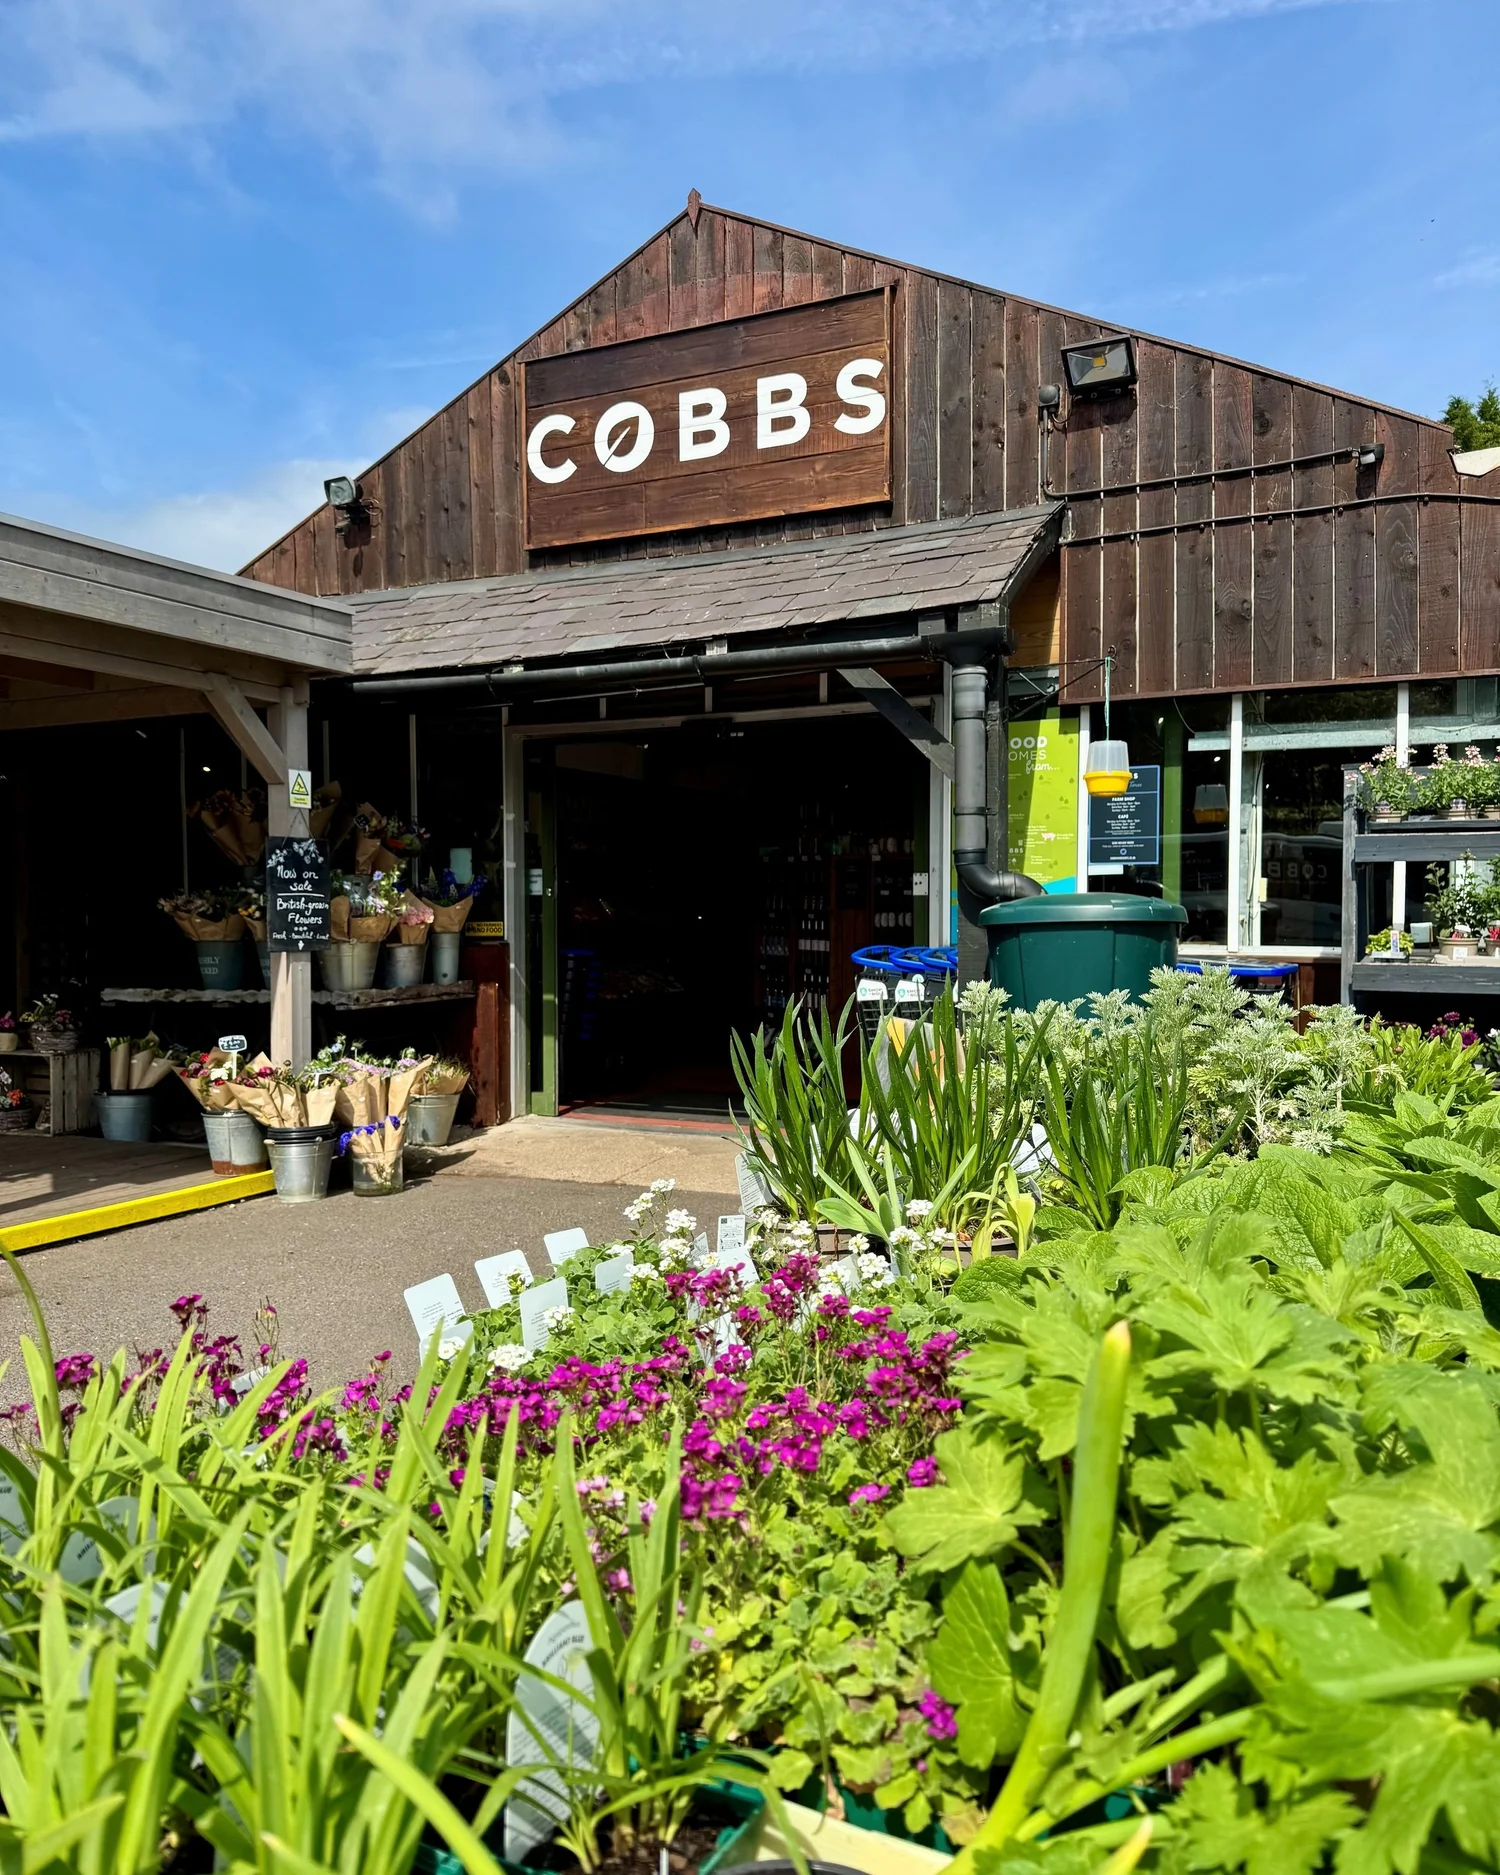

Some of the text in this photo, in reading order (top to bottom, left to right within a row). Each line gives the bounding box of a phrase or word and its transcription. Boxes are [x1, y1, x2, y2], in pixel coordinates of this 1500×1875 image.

[526, 358, 886, 484] COBBS
[1010, 736, 1047, 749] OOD
[1008, 749, 1047, 761] OMES
[277, 865, 319, 879] Now on
[289, 880, 313, 891] sale
[276, 897, 329, 915] British-grown
[288, 913, 322, 924] Flowers
